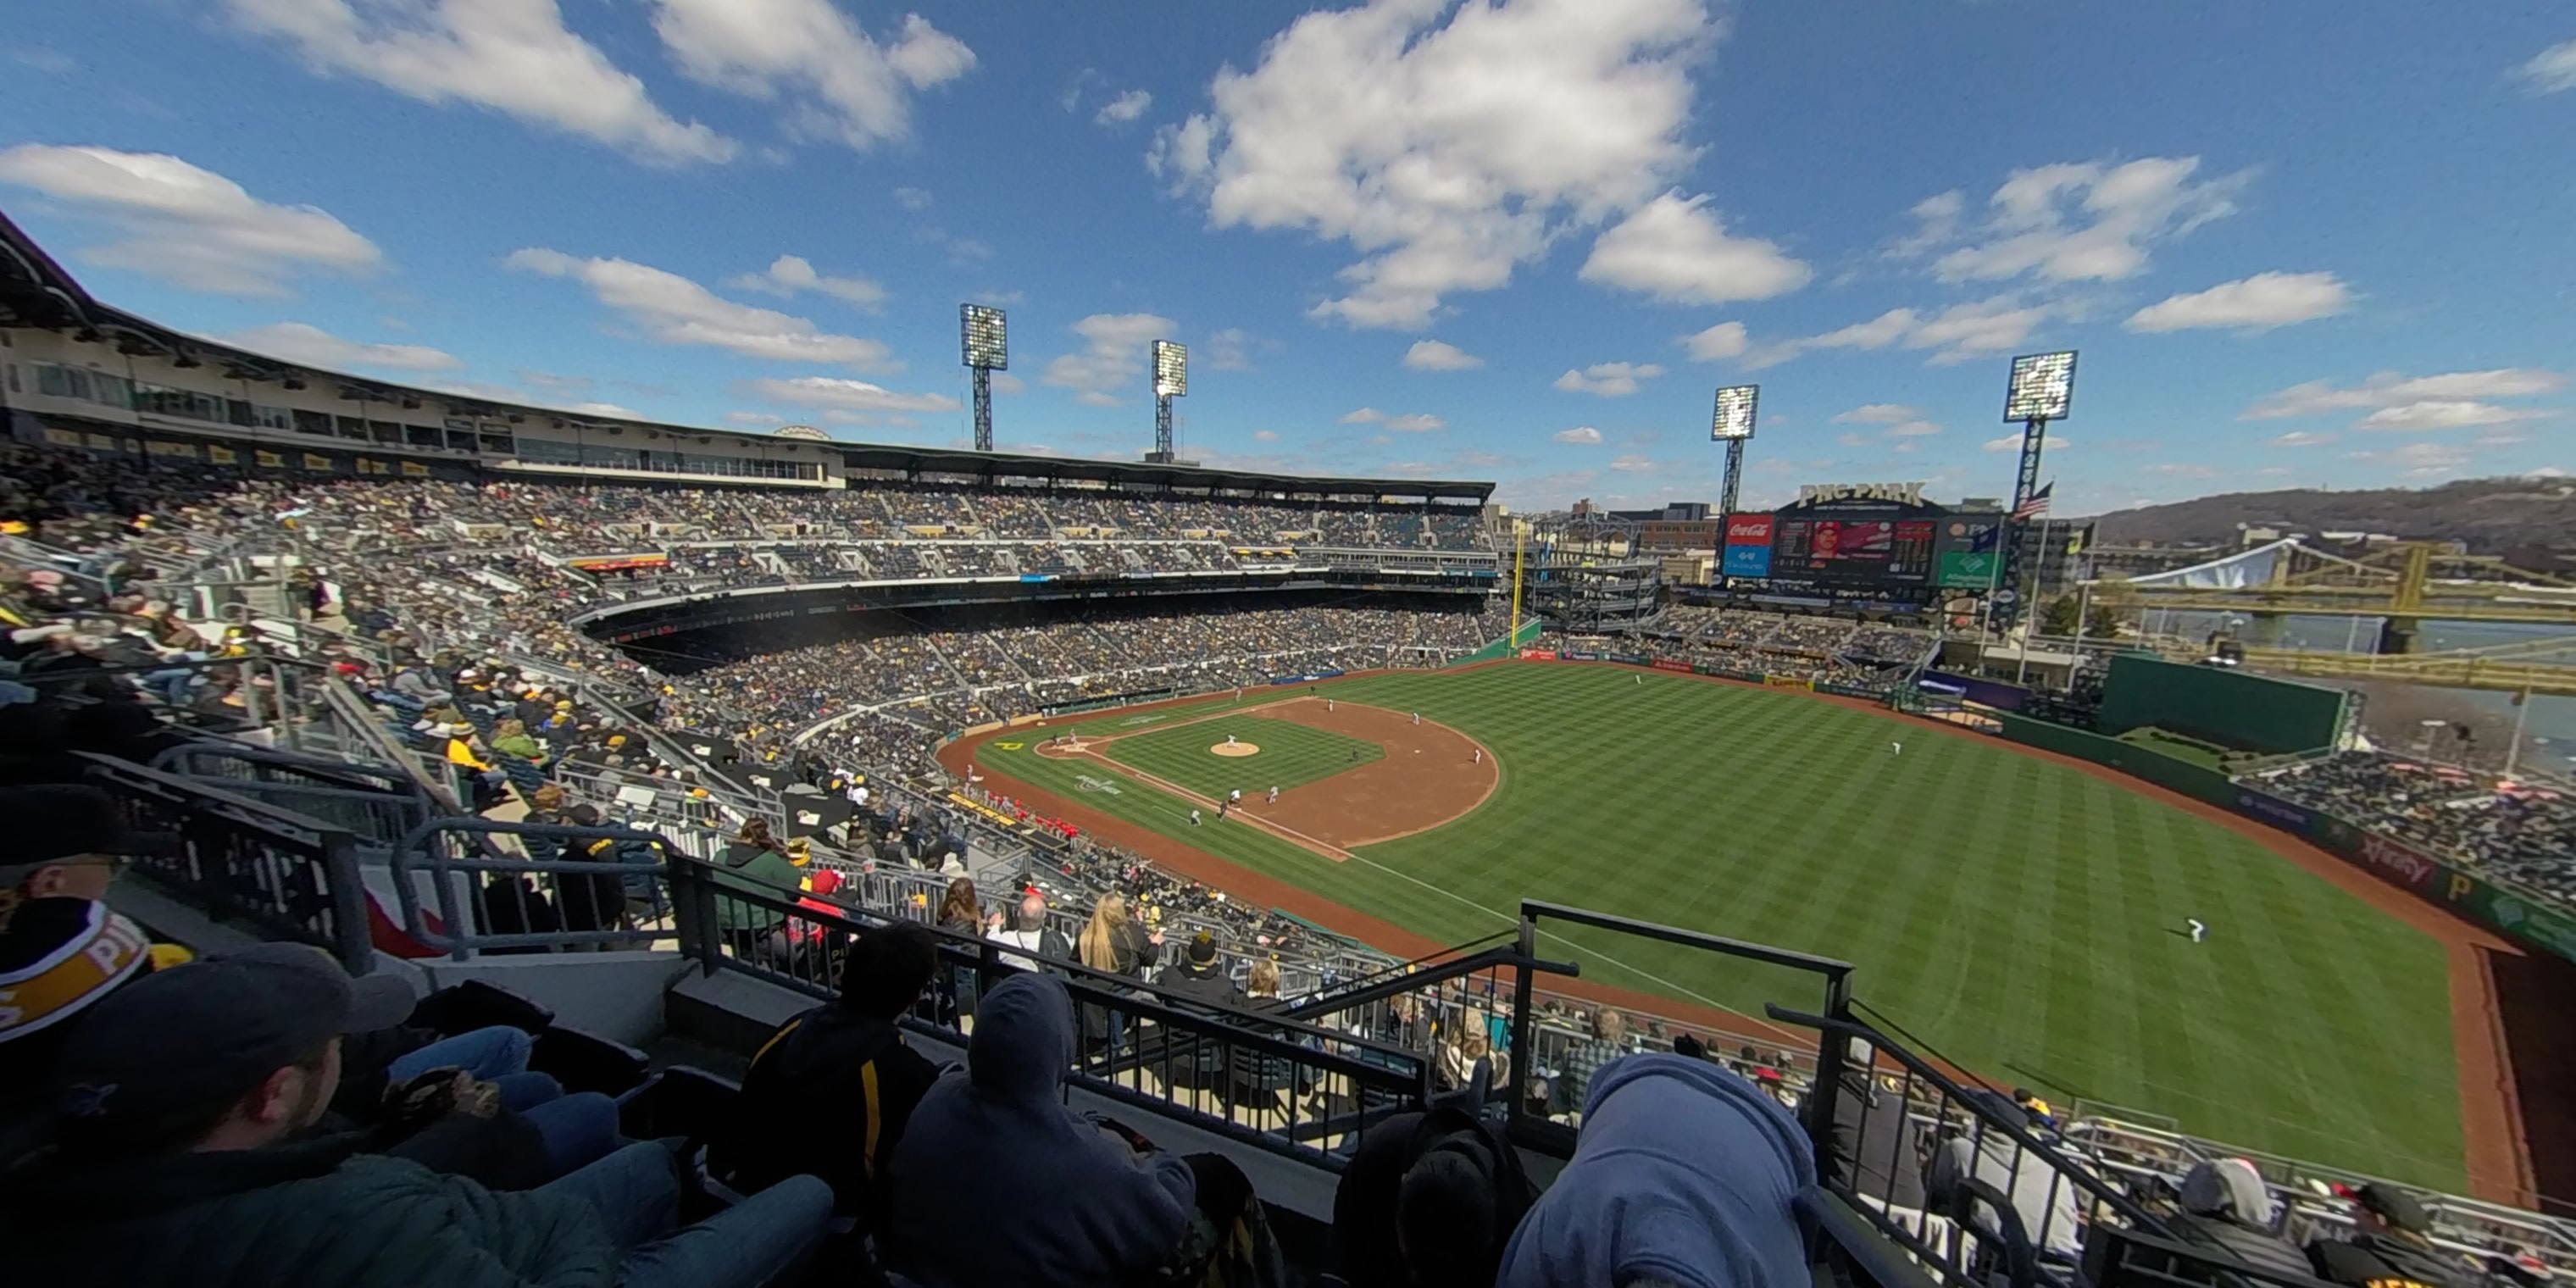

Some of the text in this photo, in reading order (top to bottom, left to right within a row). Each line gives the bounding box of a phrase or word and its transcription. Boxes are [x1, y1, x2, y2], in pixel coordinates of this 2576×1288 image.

[1797, 482, 1925, 508] PNC PARK
[2448, 873, 2471, 901] P
